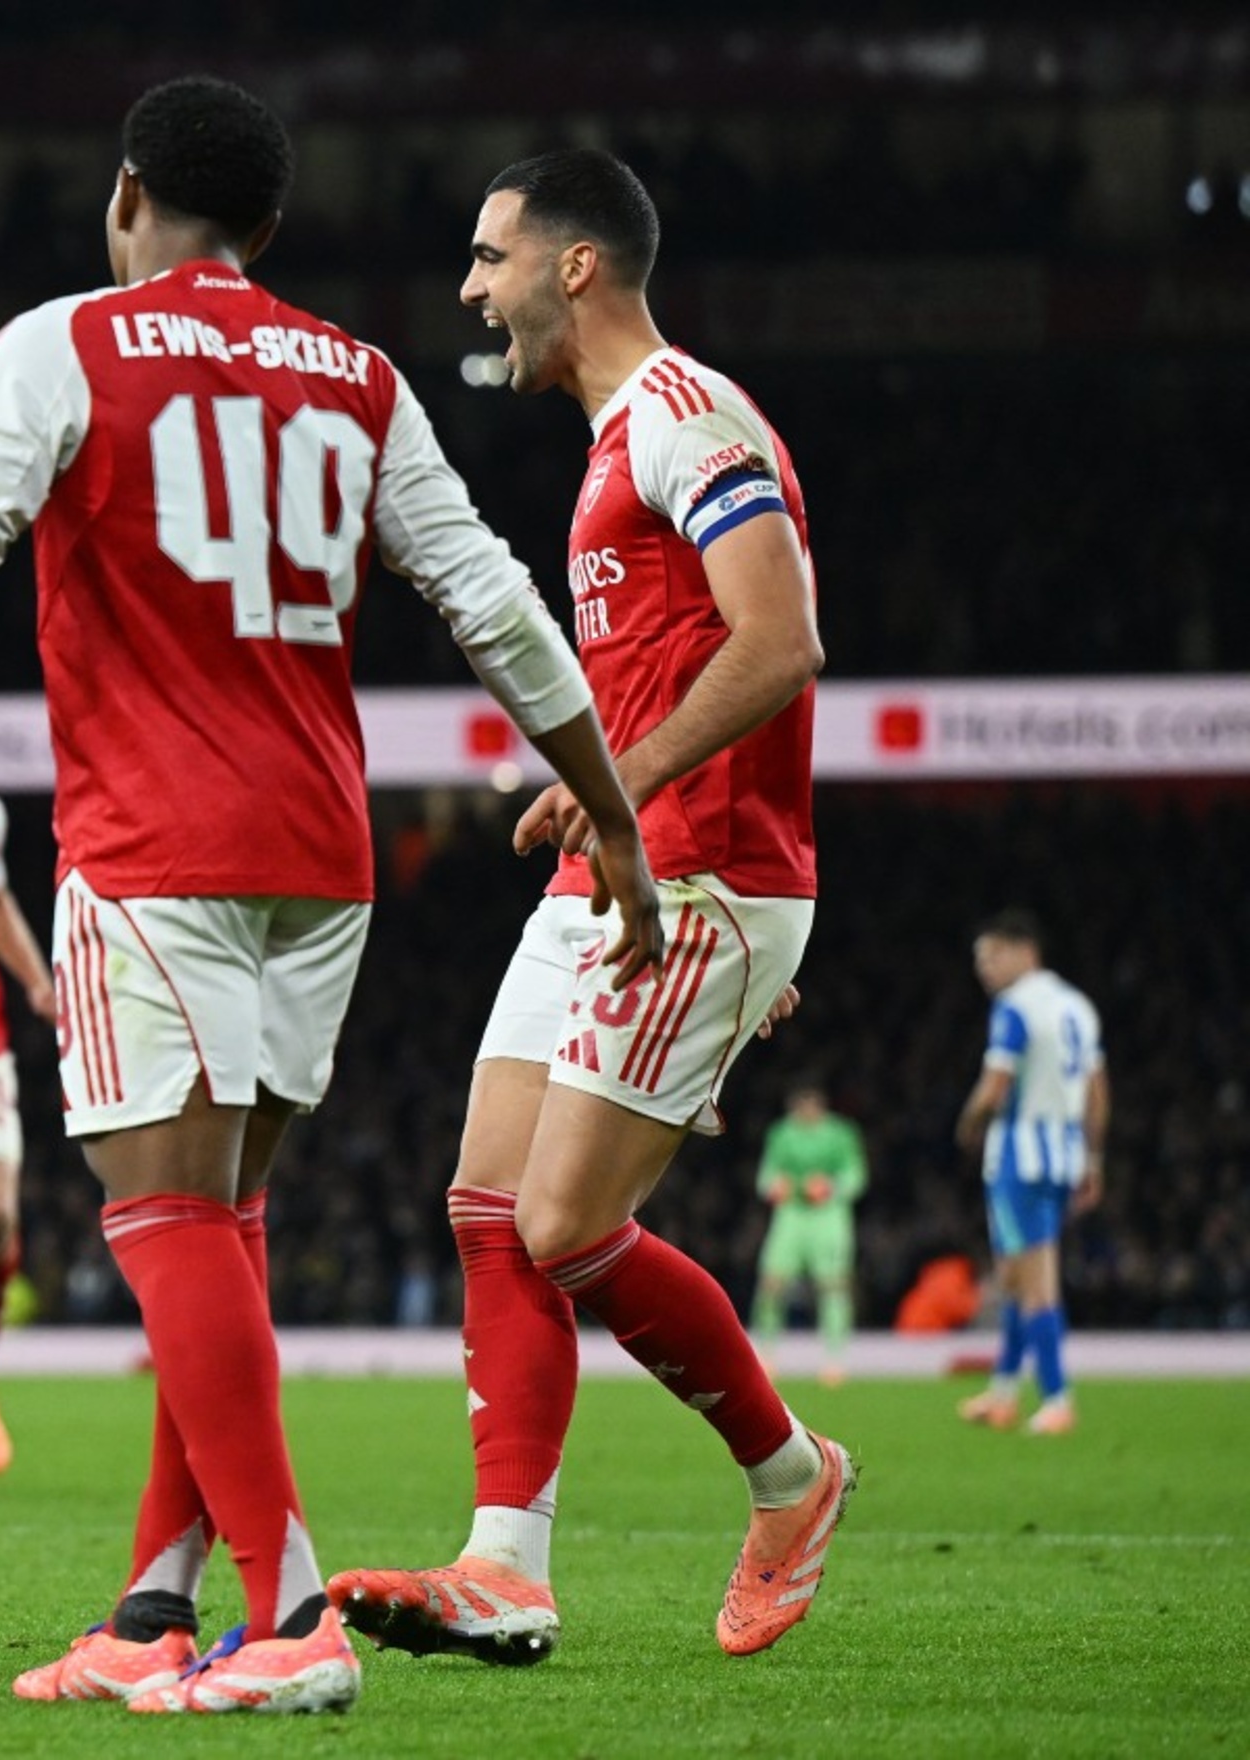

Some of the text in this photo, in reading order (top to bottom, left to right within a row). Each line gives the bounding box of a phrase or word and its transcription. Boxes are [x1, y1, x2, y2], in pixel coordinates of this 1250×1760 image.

[110, 312, 370, 386] LEWIS-SKELLY
[695, 443, 747, 475] VISIT
[148, 393, 376, 647] 49
